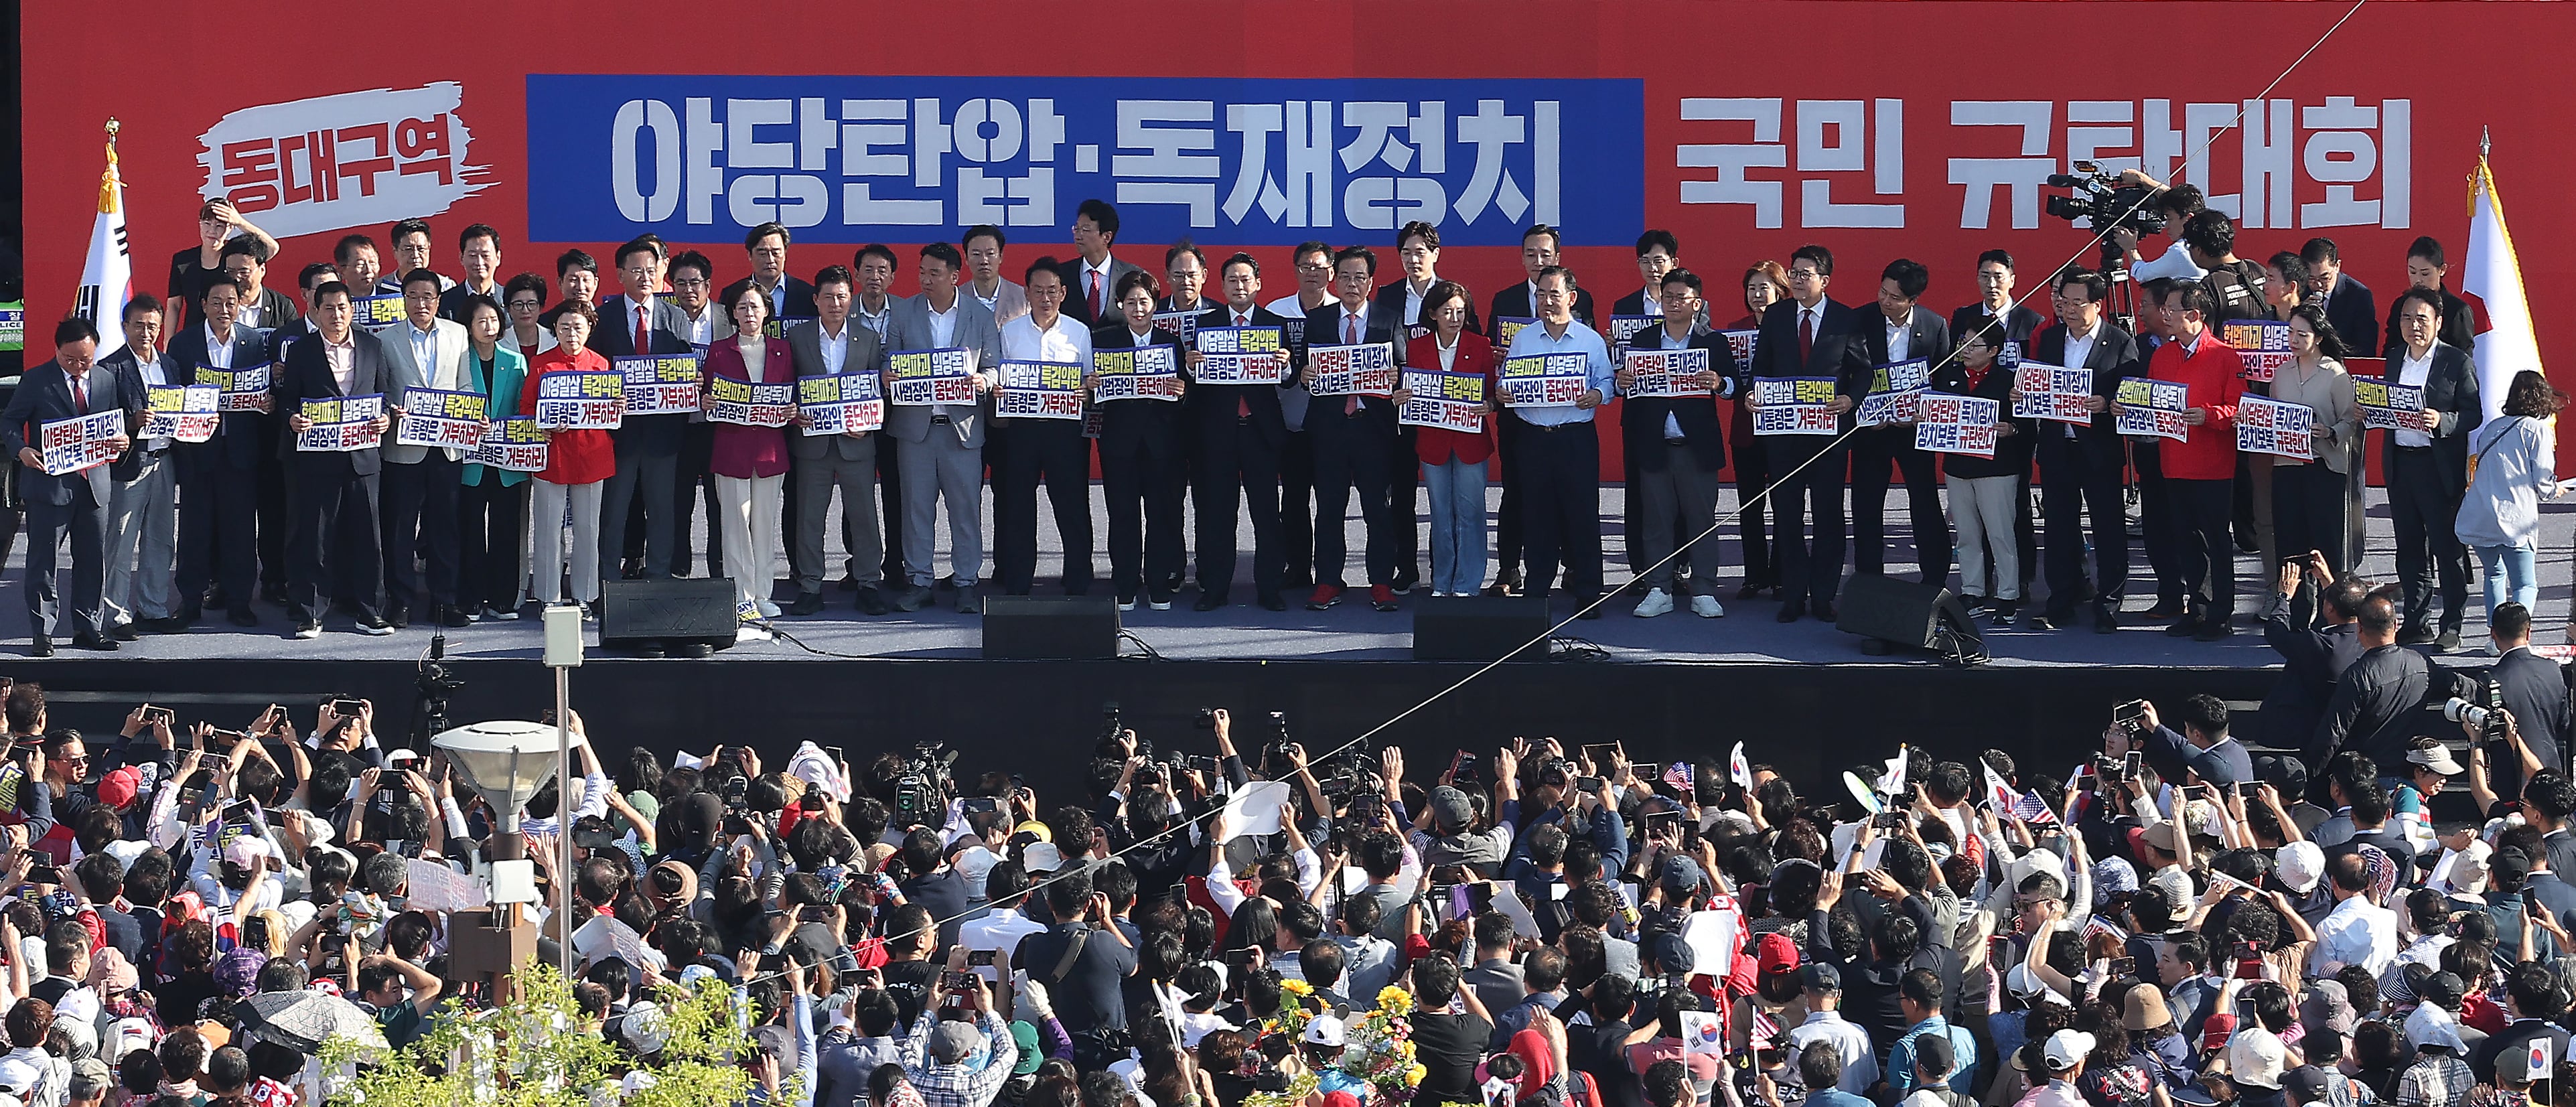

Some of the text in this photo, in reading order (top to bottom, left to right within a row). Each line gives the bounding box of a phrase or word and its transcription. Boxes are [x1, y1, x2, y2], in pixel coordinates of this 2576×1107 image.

[220, 110, 455, 215] 동대구역
[1676, 98, 1905, 230] 국민
[1948, 96, 2411, 230] 규탄대회
[1198, 330, 1279, 352] 야당말살 특검악법
[2224, 325, 2291, 350] 헌법파괴 일당독
[658, 358, 697, 382] 특검악법
[890, 353, 931, 378] 헌법파괴
[1094, 348, 1175, 374] 헌법파괴 일당독재
[1240, 358, 1281, 380] 거부하라
[1310, 350, 1350, 374] 야당탄압
[1352, 346, 1390, 370] 독재정치
[1505, 354, 1586, 376] 헌법파괴 일당독재
[1628, 351, 1707, 376] 야당탄압 독재정치
[235, 364, 271, 390] 일당독재
[540, 374, 622, 397] 야당말살 특검악법
[800, 374, 881, 403] 헌법파괴 일당독재
[999, 363, 1081, 388] 야당말살 특검악법
[1311, 374, 1350, 394] 정치보복
[1443, 375, 1482, 401] 특검악법
[1889, 361, 1928, 391] 일당독재
[2015, 368, 2090, 394] 야당탄압 독재정치
[148, 387, 184, 411] 헌법파괴
[184, 388, 219, 413] 일당독재
[624, 386, 697, 411] 통령은 거부하라
[711, 377, 793, 403] 헌법파괴 일당독재
[893, 382, 932, 401] 사법장악
[1545, 379, 1585, 403] 중단하라
[1754, 380, 1835, 404] 야당말살 특검악법
[2117, 380, 2186, 412] 헌법파괴 일당독재
[2356, 380, 2423, 410] 헌법파괴 일당독재
[342, 397, 382, 421] 일당독재
[404, 390, 485, 420] 야당말살 특검악법
[540, 402, 620, 424] 대통령은 거부하라
[843, 403, 881, 429] 중단하라
[999, 392, 1080, 415] 대통령은 거부하라
[1894, 393, 1921, 418] 중단하
[1922, 399, 1999, 425] 야당탄압 독재정치
[44, 411, 122, 449] 야당탄압 독재정치
[2239, 402, 2310, 432] 야당탄압 독재정치
[401, 418, 480, 446] 대통령은 거부하라
[1918, 423, 1995, 449] 정치보복 규탄한다
[2238, 427, 2310, 455] 정치보복 규탄한다
[46, 444, 83, 473] 정치보복
[506, 447, 545, 467] 거부하라
[1743, 1084, 1798, 1100] KEA
